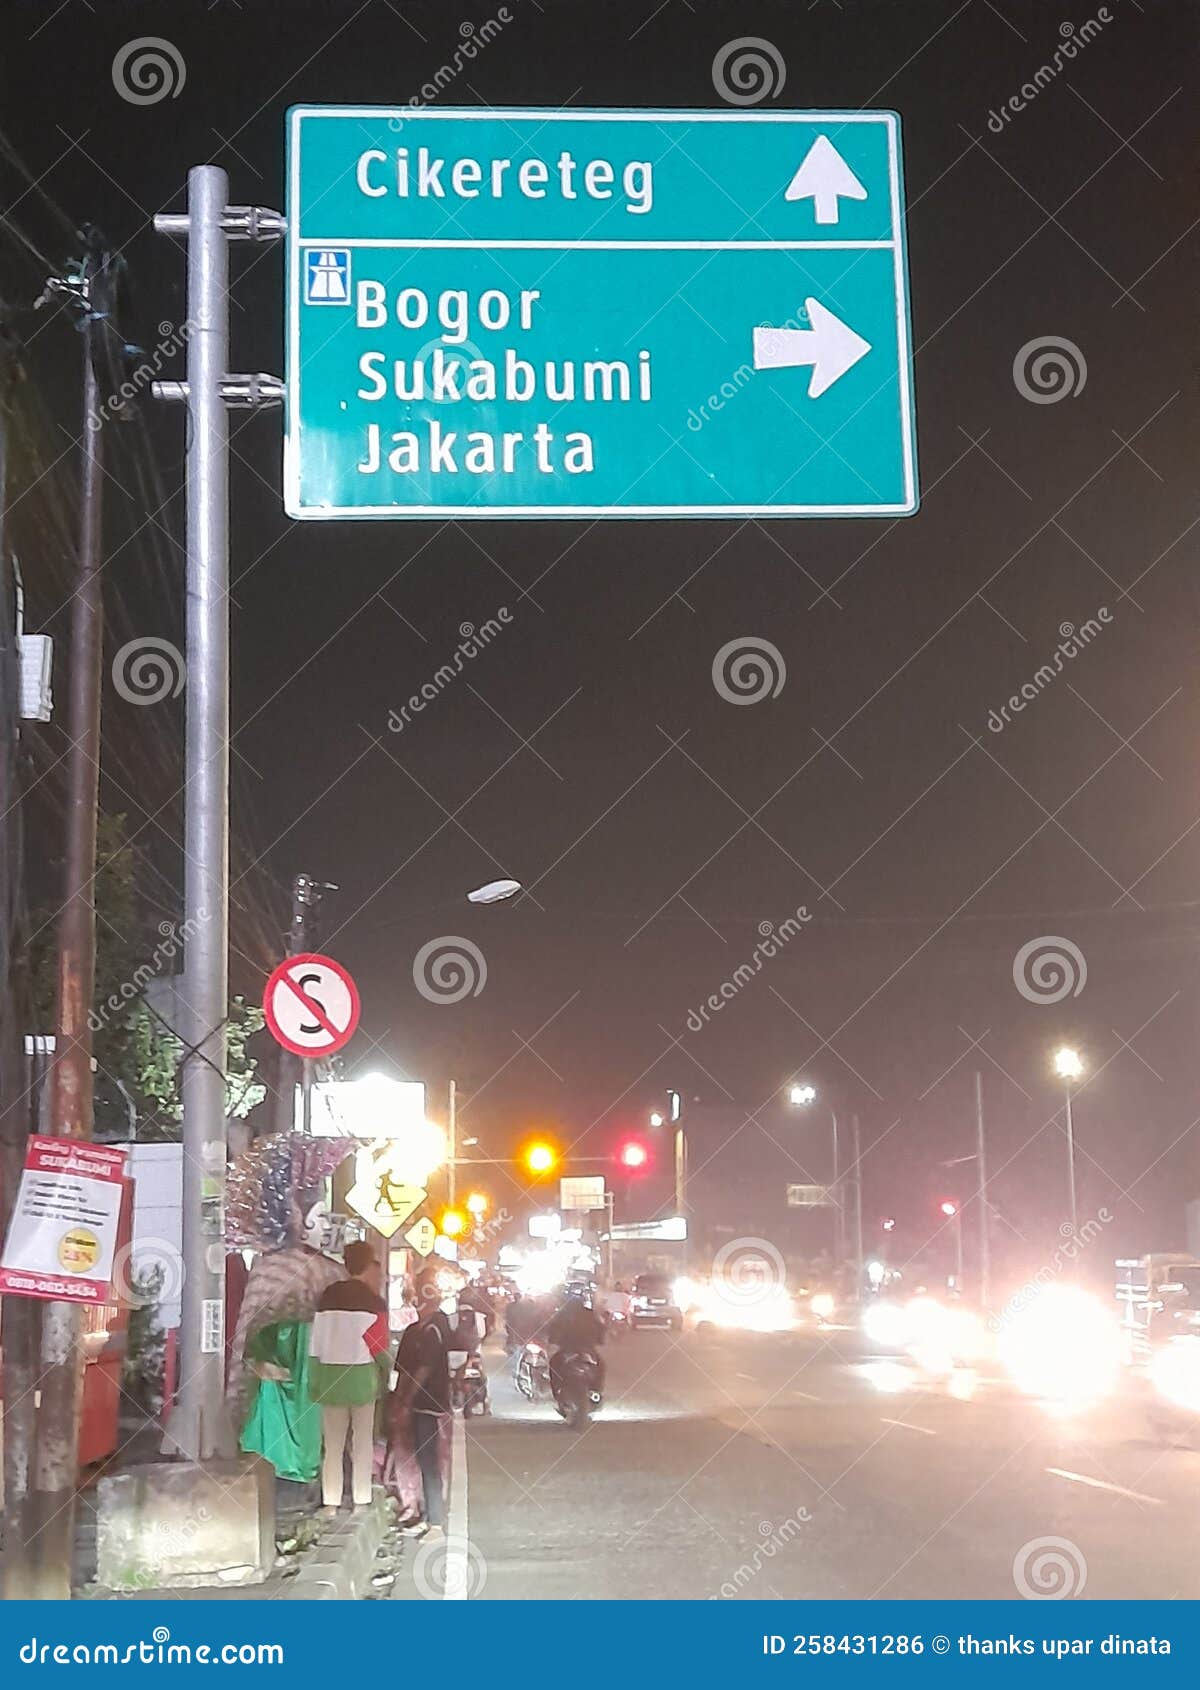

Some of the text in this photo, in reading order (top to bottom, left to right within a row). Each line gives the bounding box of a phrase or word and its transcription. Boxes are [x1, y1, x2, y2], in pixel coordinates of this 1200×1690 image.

[356, 147, 654, 213] Cikereteg
[356, 280, 541, 342] Bogor
[358, 349, 652, 402] Sukabumi
[357, 422, 595, 474] Jakarta
